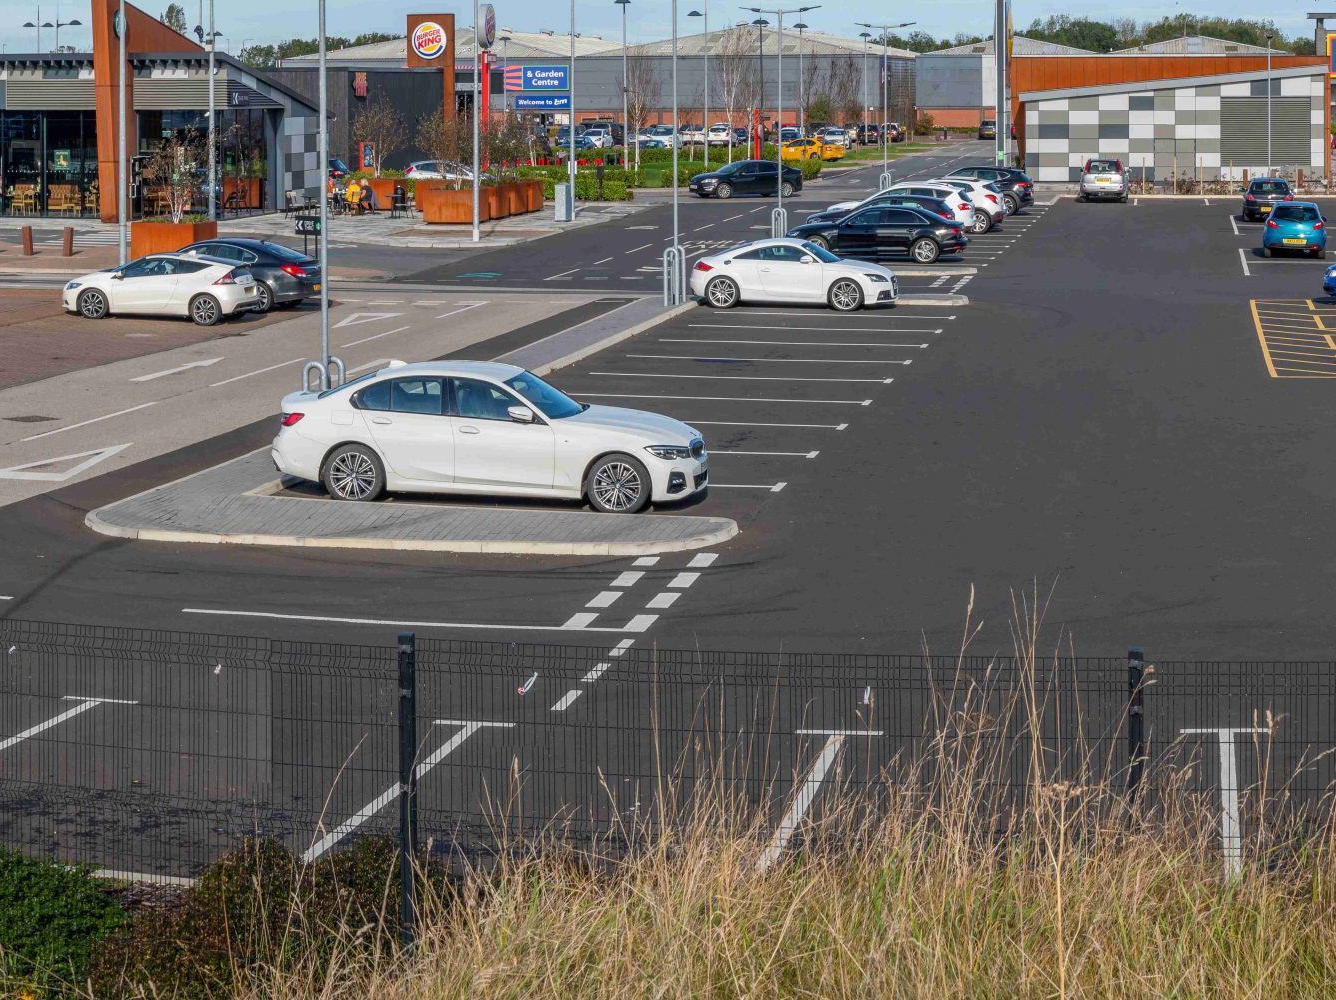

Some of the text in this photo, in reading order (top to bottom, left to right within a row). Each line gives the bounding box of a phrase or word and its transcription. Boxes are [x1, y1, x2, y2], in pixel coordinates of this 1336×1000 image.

[416, 28, 441, 42] BURGER
[417, 34, 442, 50] KING
[526, 70, 564, 78] & Garden
[532, 78, 559, 86] Centre
